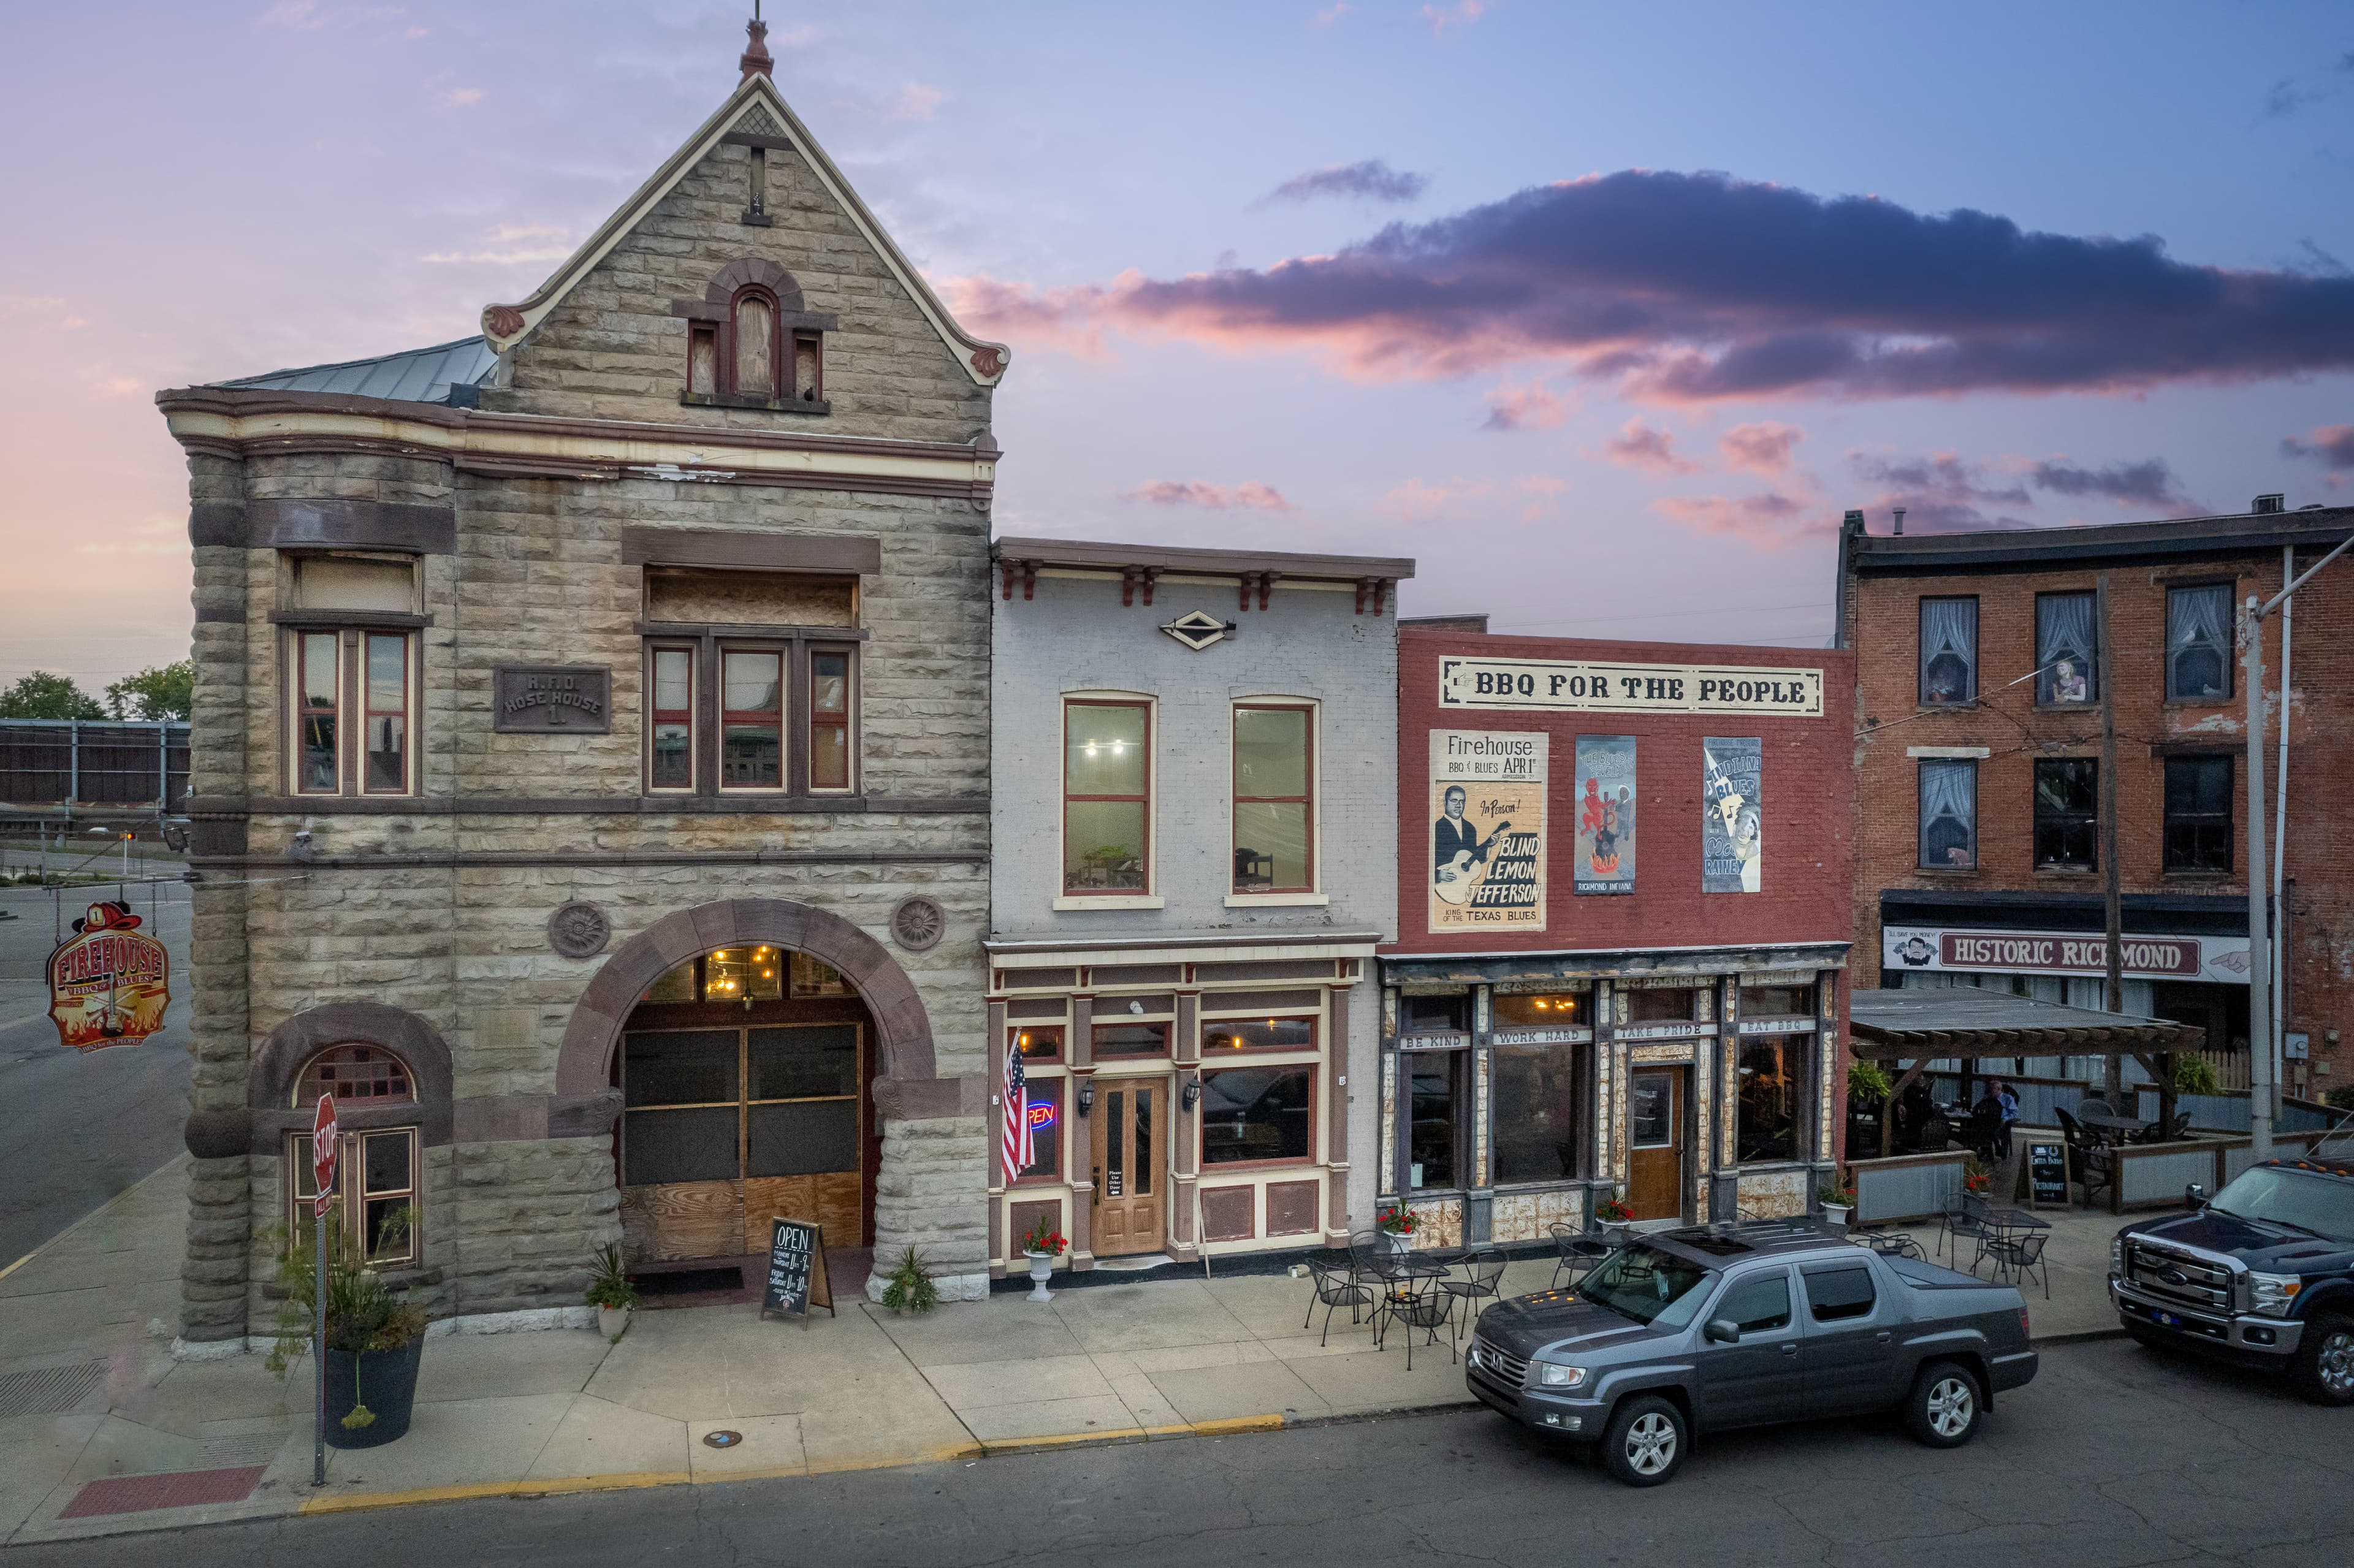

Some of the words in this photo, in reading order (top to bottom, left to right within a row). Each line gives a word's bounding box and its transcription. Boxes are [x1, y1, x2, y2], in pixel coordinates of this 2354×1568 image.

[1475, 672, 1535, 696] BBQ
[1548, 674, 1610, 698] FOR
[1621, 677, 1684, 701] THE
[1698, 679, 1805, 704] PEOPLE
[505, 692, 546, 713] HOSE
[552, 692, 601, 714] HOUSE
[1448, 736, 1533, 755] Firehouse
[1449, 762, 1464, 772] BBQ
[1475, 763, 1498, 773] BLUES
[1579, 753, 1598, 766] THE
[1599, 751, 1626, 765] BLUES
[1708, 756, 1761, 783] INDIANA
[1716, 779, 1755, 801] BLUES
[1480, 801, 1490, 816] In
[1499, 836, 1542, 857] BLIND
[1486, 861, 1537, 880] LEMON
[1705, 859, 1746, 875] RAINEY
[1466, 883, 1541, 904] JEFFERSON
[93, 911, 99, 921] 1
[1466, 911, 1501, 920] TEXAS
[1507, 911, 1536, 920] BLUES
[1954, 938, 2053, 964] HISTORIC
[57, 935, 162, 988] FIREHOUSE
[74, 984, 99, 995] BBQ
[118, 975, 150, 986] BLUES
[1621, 1027, 1653, 1038] TAKE
[1664, 1024, 1701, 1036] PRIDE
[1747, 1021, 1770, 1032] EAT
[1778, 1020, 1801, 1031] BBQ
[1406, 1038, 1423, 1048] BE
[1430, 1035, 1461, 1047] KIND
[1499, 1033, 1537, 1044] WORK
[1545, 1030, 1579, 1041] HARD
[1029, 1105, 1054, 1124] PEN
[315, 1121, 336, 1166] STOP
[777, 1226, 809, 1250] OPEN
[769, 1277, 786, 1287] SATURDAY
[771, 1269, 785, 1278] FRIDAY
